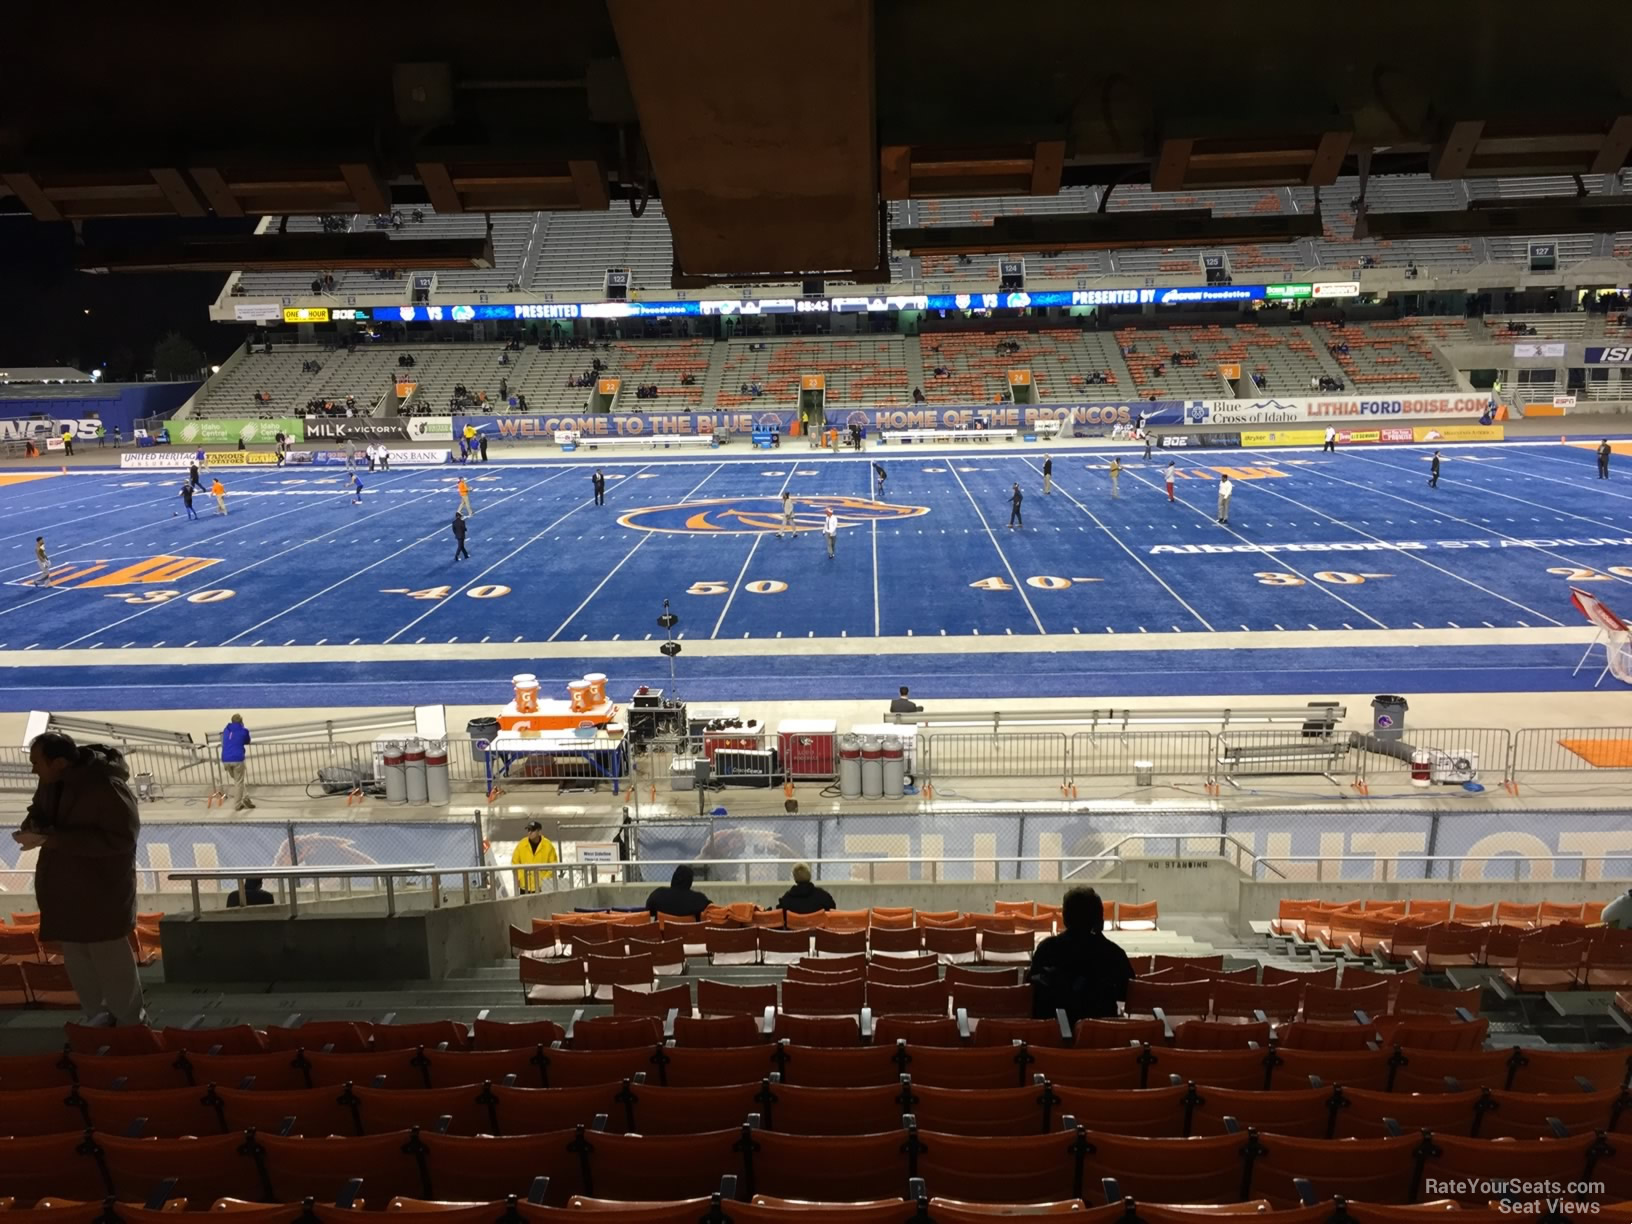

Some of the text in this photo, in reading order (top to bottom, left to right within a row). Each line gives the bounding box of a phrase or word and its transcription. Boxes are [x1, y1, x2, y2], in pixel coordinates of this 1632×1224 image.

[1536, 247, 1549, 255] 127
[1206, 258, 1219, 266] 125
[613, 275, 625, 283] 122
[982, 293, 998, 307] VS
[1072, 290, 1138, 305] PRESENTED
[1140, 289, 1156, 303] BY
[1203, 290, 1251, 300] Foundation
[426, 306, 443, 320] VS
[514, 305, 579, 319] PRESENTED
[1213, 401, 1242, 412] Blue
[1307, 398, 1488, 417] LITHIAFORDBOISE.COM
[876, 405, 1131, 430] HOME OF THE BRONCOS
[1212, 411, 1297, 424] Cross of Idaho
[260, 422, 280, 430] Idaho
[307, 423, 346, 437] MILK
[496, 414, 753, 437] WELCOME TO THE BLUE
[201, 429, 228, 437] Central
[124, 452, 197, 461] UNITED HERITAG
[410, 451, 437, 459] BANK
[1148, 541, 1427, 555] Albertsons
[522, 692, 531, 702] G
[573, 692, 581, 701] G
[1148, 861, 1208, 869] NO STANDING
